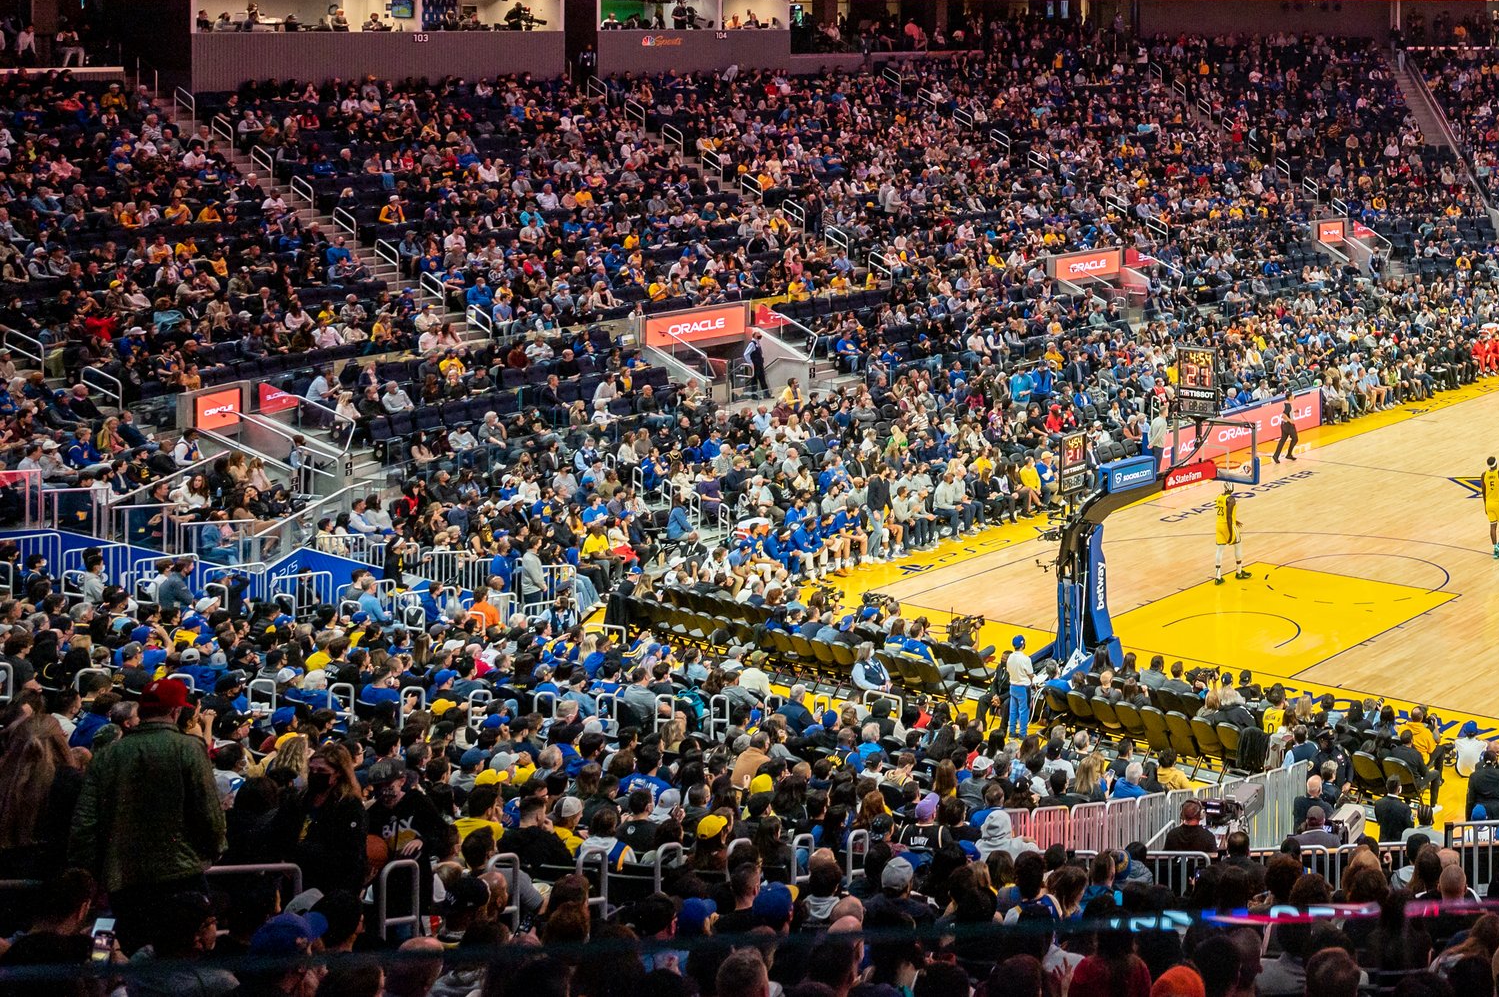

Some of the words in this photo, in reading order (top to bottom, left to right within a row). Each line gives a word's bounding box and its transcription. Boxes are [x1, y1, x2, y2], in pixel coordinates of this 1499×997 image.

[412, 34, 429, 43] 103
[1069, 259, 1107, 273] ORACLE
[668, 318, 725, 336] ORACLE
[1190, 352, 1212, 365] 4:54
[1187, 365, 1209, 386] 21
[1190, 390, 1215, 399] TISSOT
[1123, 468, 1152, 482] socios.com
[1251, 470, 1314, 492] CENTER
[1096, 561, 1106, 611] betway
